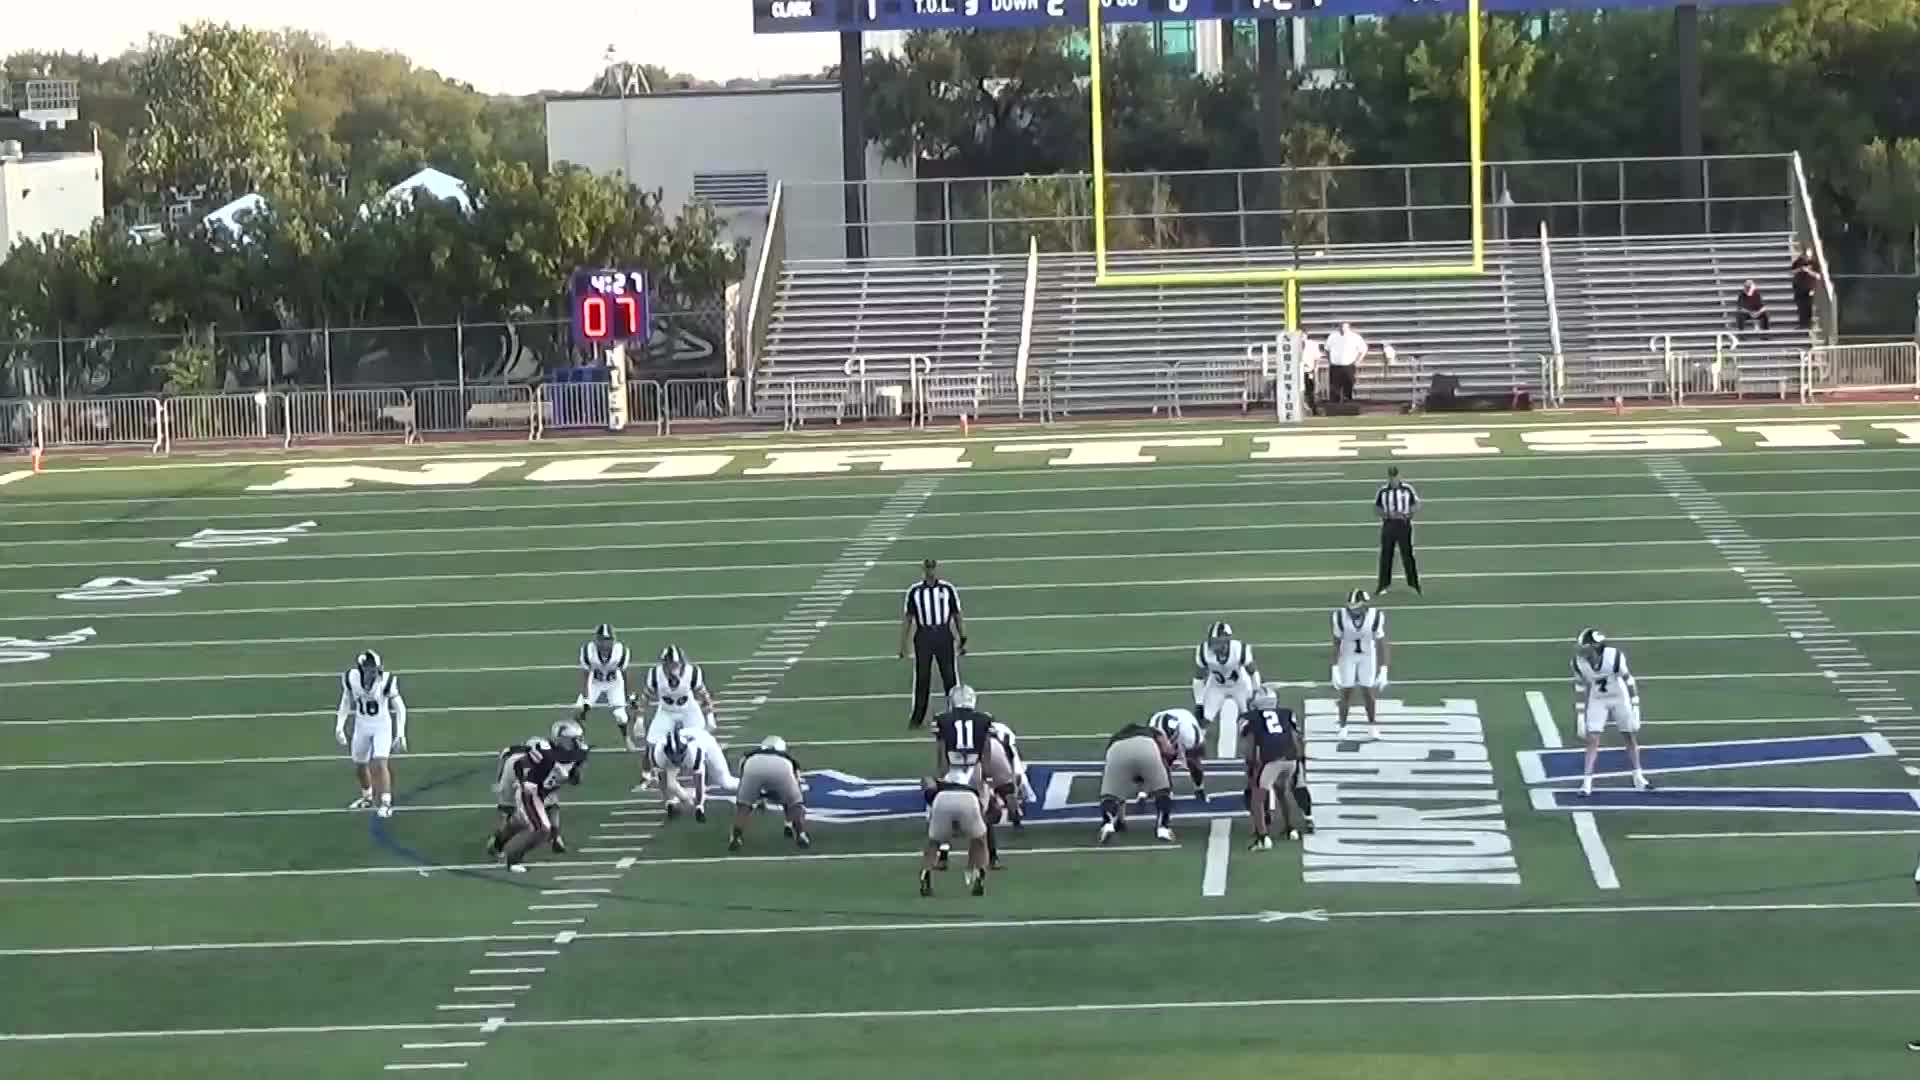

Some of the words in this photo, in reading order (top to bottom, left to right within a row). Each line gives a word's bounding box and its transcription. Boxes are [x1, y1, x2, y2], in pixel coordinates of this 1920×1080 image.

[591, 272, 642, 295] 4:27
[583, 298, 636, 337] 07
[245, 422, 1920, 491] NORTHSI
[953, 719, 976, 750] 11
[1262, 710, 1284, 735] 2
[1302, 699, 1521, 885] NORTHSIDE
